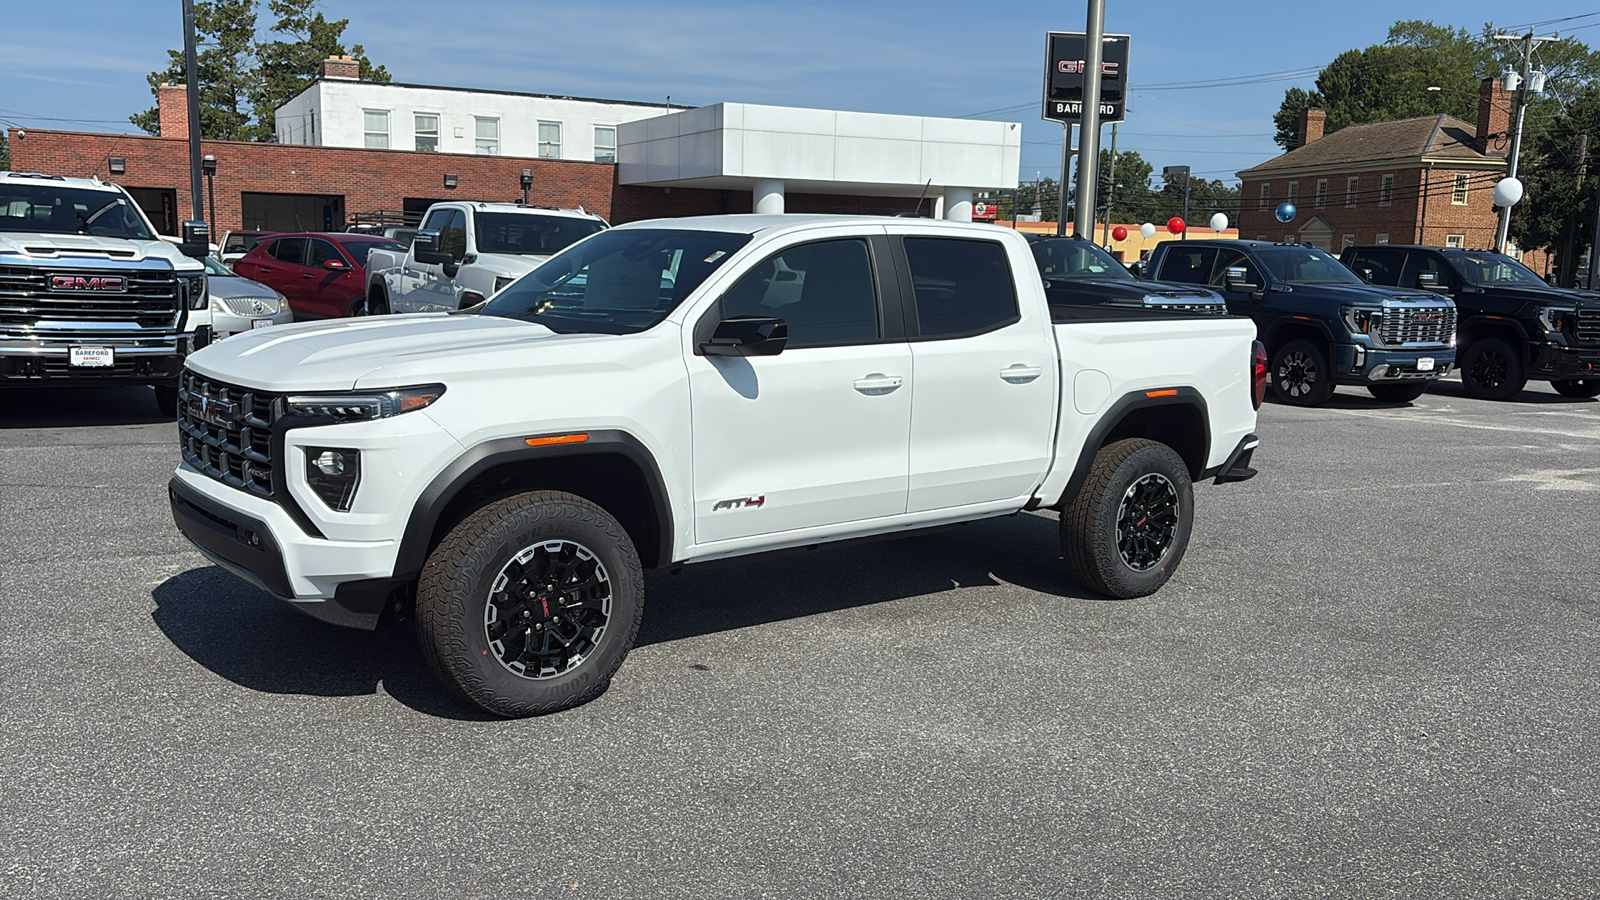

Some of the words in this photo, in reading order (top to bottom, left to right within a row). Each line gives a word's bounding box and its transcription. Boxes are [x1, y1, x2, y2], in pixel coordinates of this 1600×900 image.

[1056, 103, 1114, 114] BARRD
[52, 276, 122, 290] GMC
[187, 391, 234, 430] GMC
[712, 495, 765, 511] AT4
